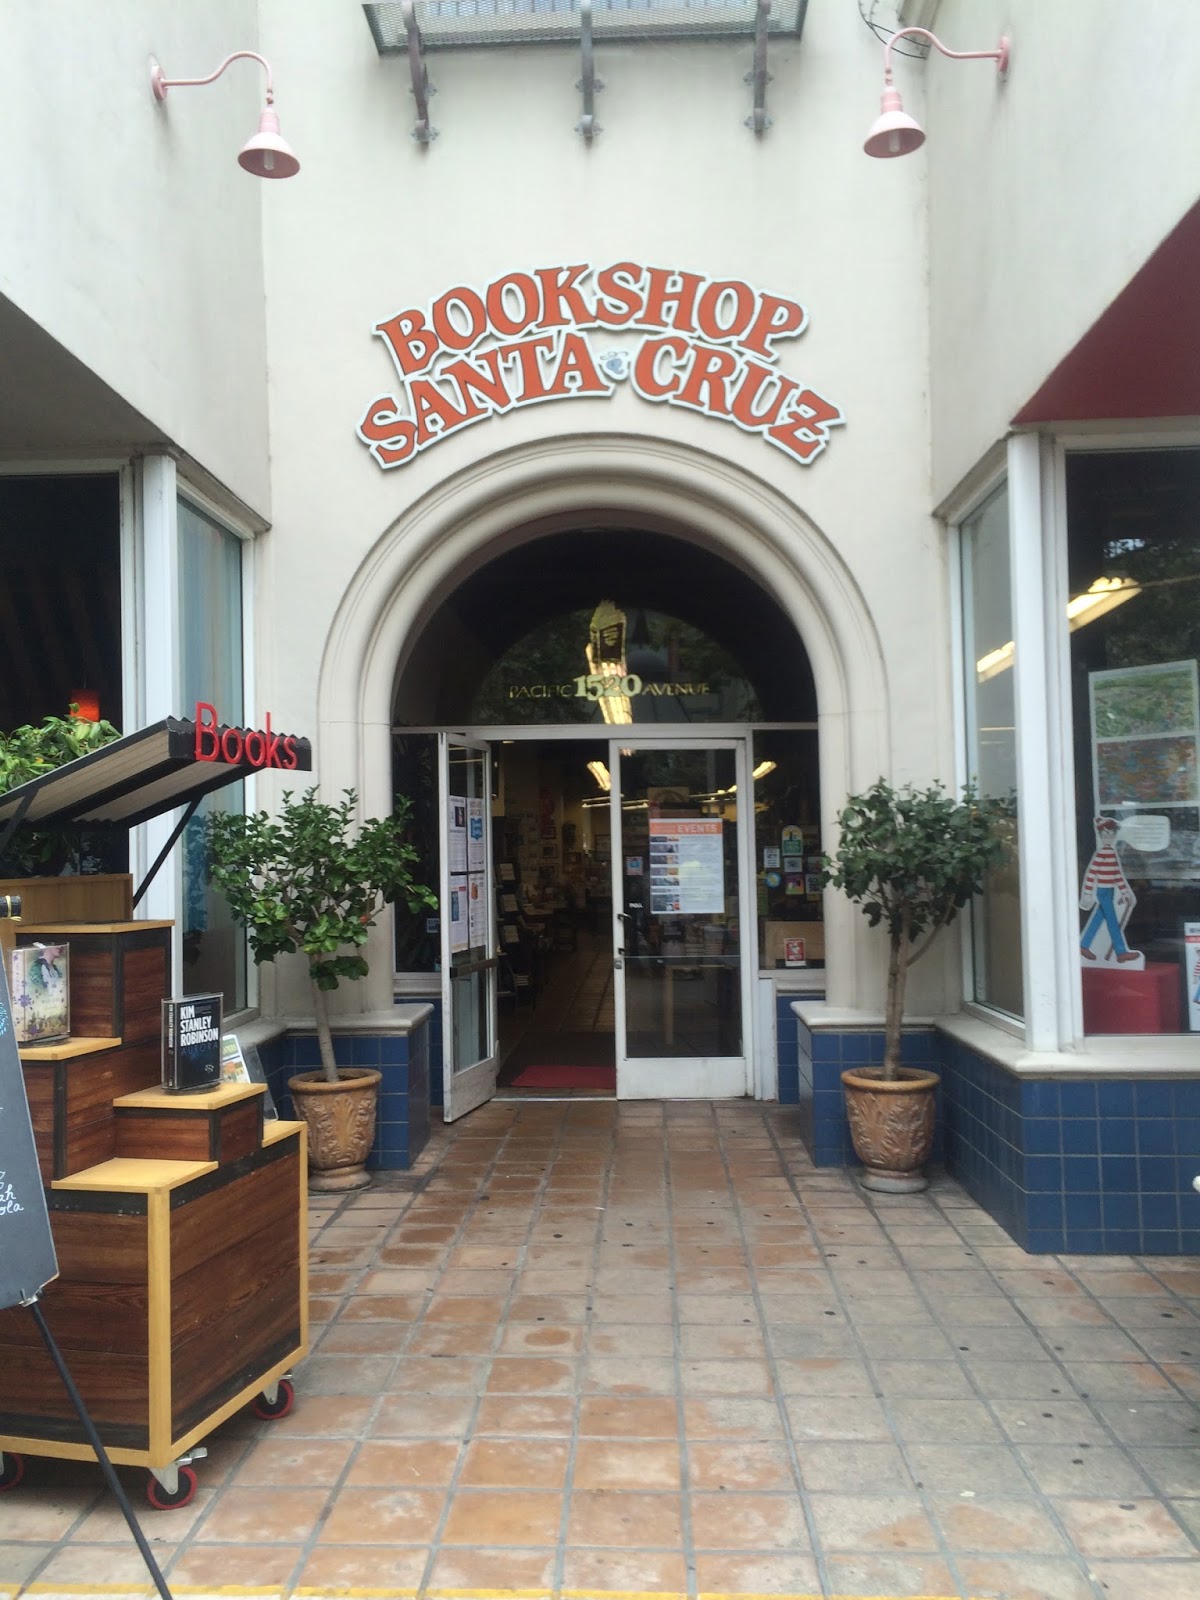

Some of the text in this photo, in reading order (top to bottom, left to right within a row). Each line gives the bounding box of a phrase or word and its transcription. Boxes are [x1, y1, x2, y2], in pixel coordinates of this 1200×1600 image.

[374, 261, 806, 375] BOOKSHOP
[358, 331, 842, 465] SANTA CRUZ
[509, 674, 710, 701] PACIFIC 1520 AVENUE
[194, 701, 297, 770] Books
[677, 824, 717, 833] EVENTS
[180, 1005, 195, 1020] KIM
[180, 1015, 212, 1033] STANLEY
[180, 1028, 219, 1047] ROBINSON
